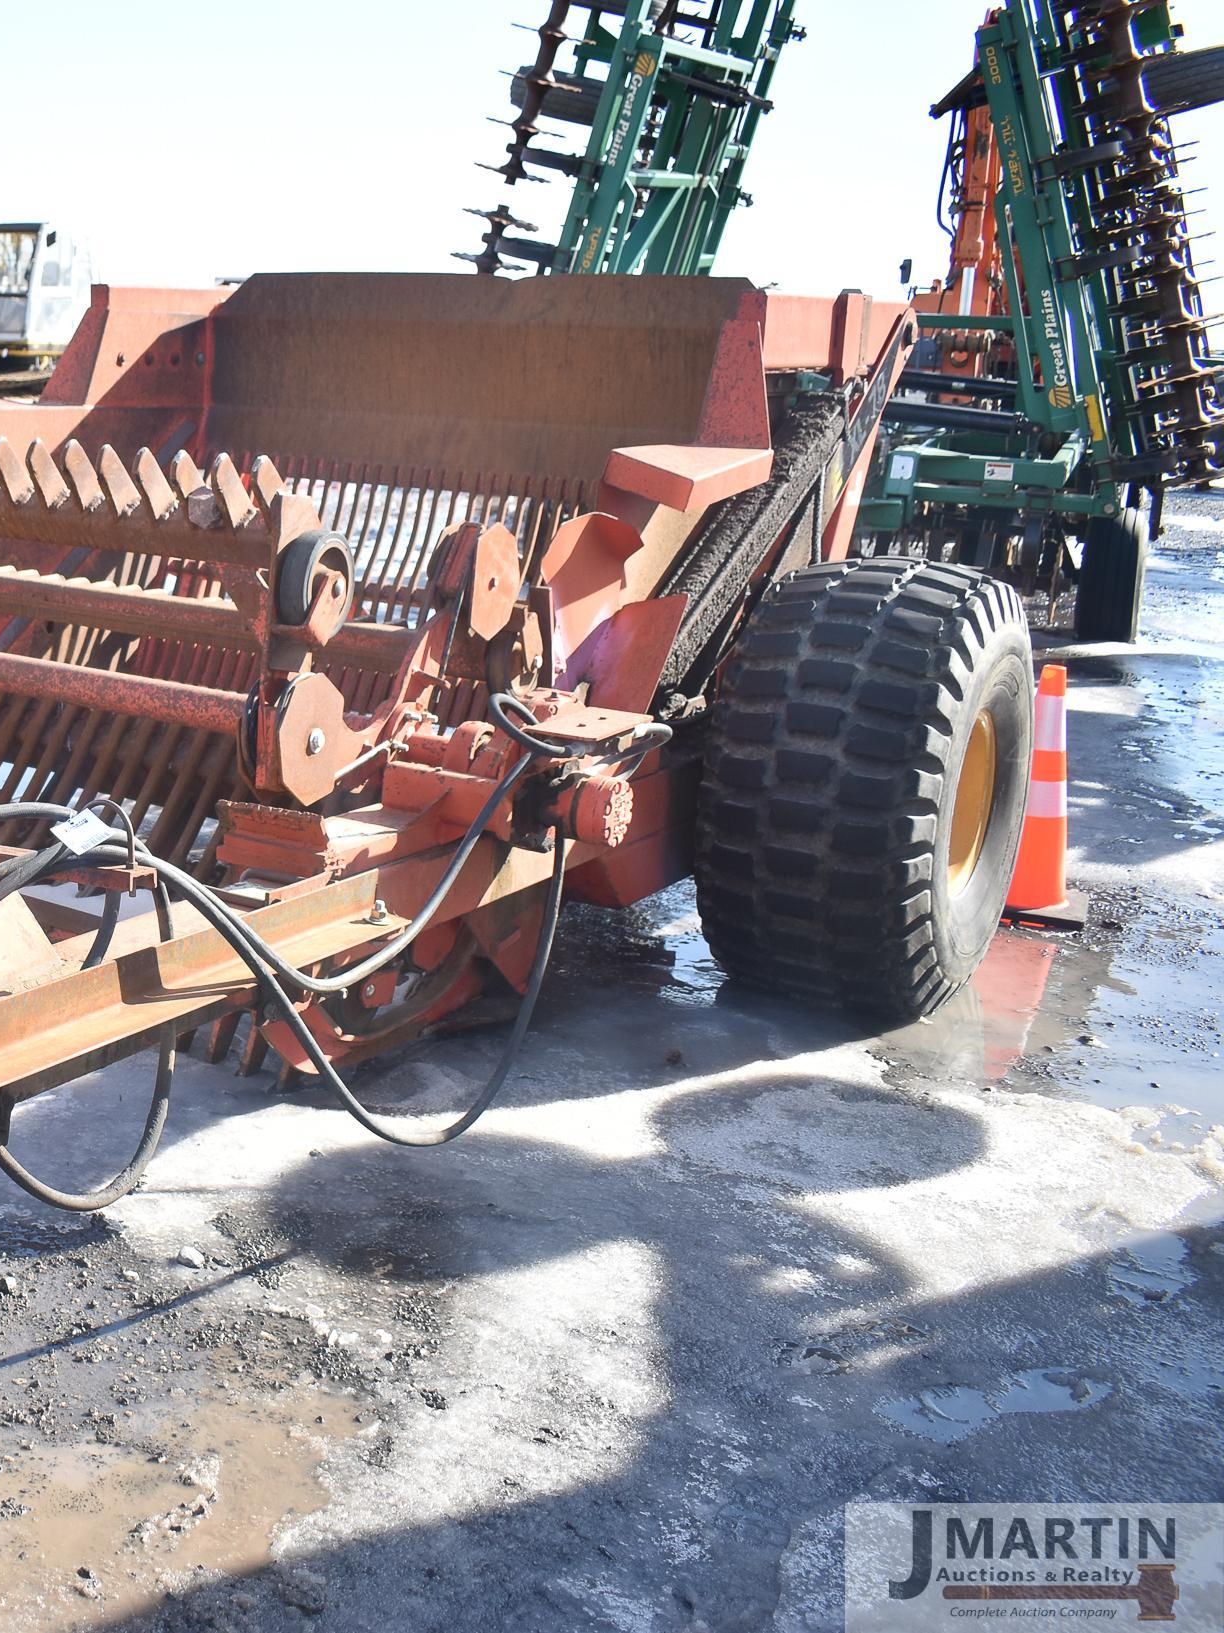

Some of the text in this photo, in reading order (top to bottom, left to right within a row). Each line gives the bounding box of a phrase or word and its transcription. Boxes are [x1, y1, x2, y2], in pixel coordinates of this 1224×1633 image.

[985, 46, 1002, 85] 3000
[608, 74, 644, 168] Great Plains
[1040, 288, 1068, 387] Great Plains
